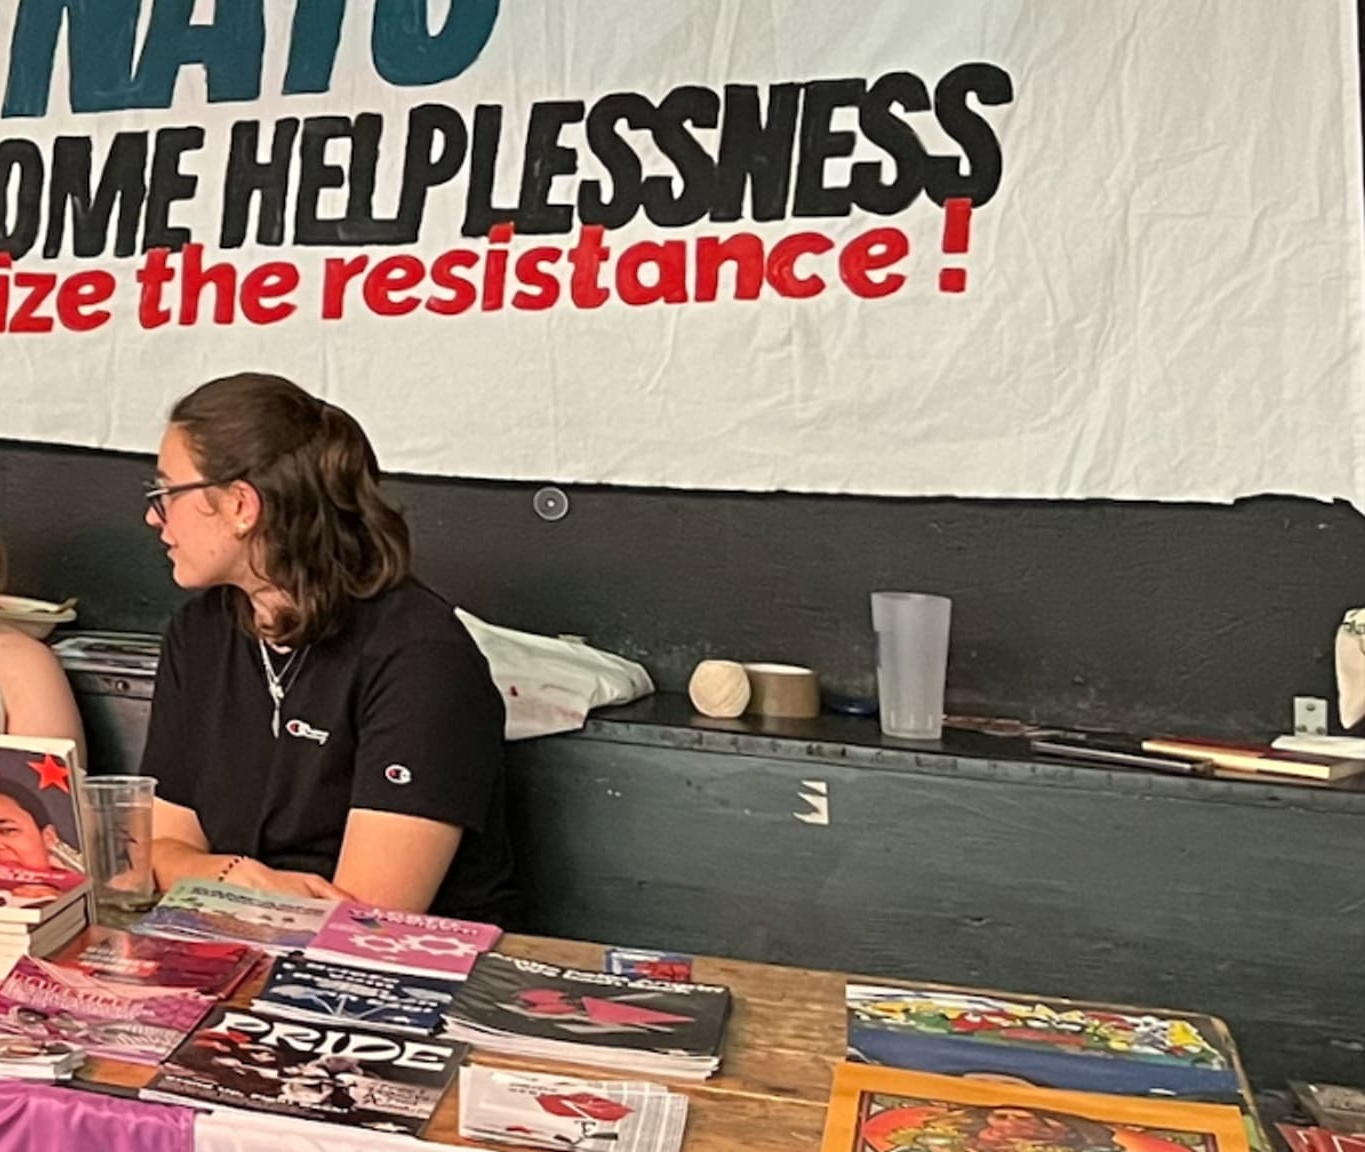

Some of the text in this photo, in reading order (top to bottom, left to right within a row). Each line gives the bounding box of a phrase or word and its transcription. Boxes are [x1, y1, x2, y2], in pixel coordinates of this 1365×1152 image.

[218, 61, 1014, 248] HELPLESSNESS
[137, 240, 299, 340] the
[321, 220, 905, 320] resistance
[216, 1012, 454, 1071] PRIDE
